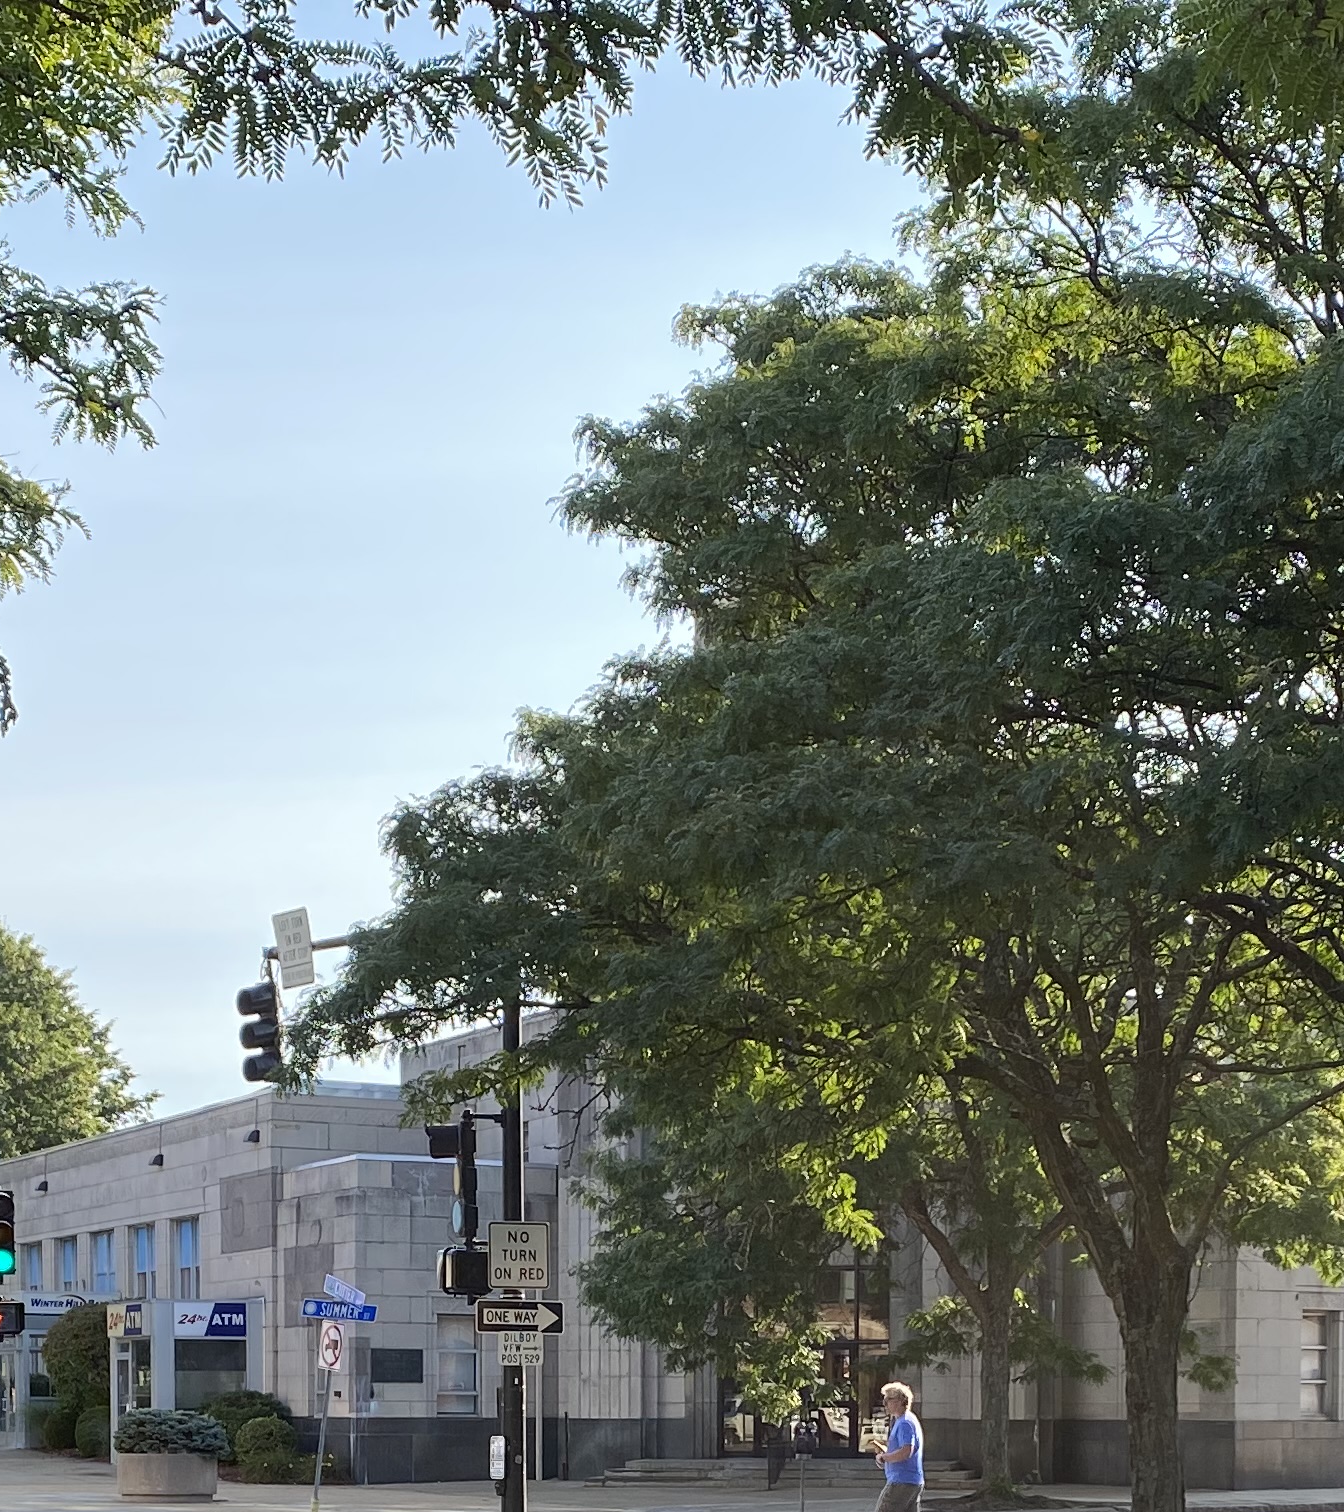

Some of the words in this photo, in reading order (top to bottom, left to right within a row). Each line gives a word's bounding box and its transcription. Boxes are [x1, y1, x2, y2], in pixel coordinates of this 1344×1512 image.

[507, 1231, 530, 1243] NO
[502, 1249, 536, 1262] TURN
[494, 1267, 511, 1280] ON
[519, 1268, 544, 1280] RED
[319, 1302, 359, 1319] SUMMER
[486, 1310, 509, 1323] ONE
[514, 1311, 538, 1323] WAY
[126, 1312, 142, 1329] ATM
[211, 1313, 244, 1326] ATM
[504, 1333, 537, 1342] DILBOY
[503, 1344, 522, 1353] VFW
[501, 1354, 523, 1363] POST
[524, 1354, 540, 1364] 529
